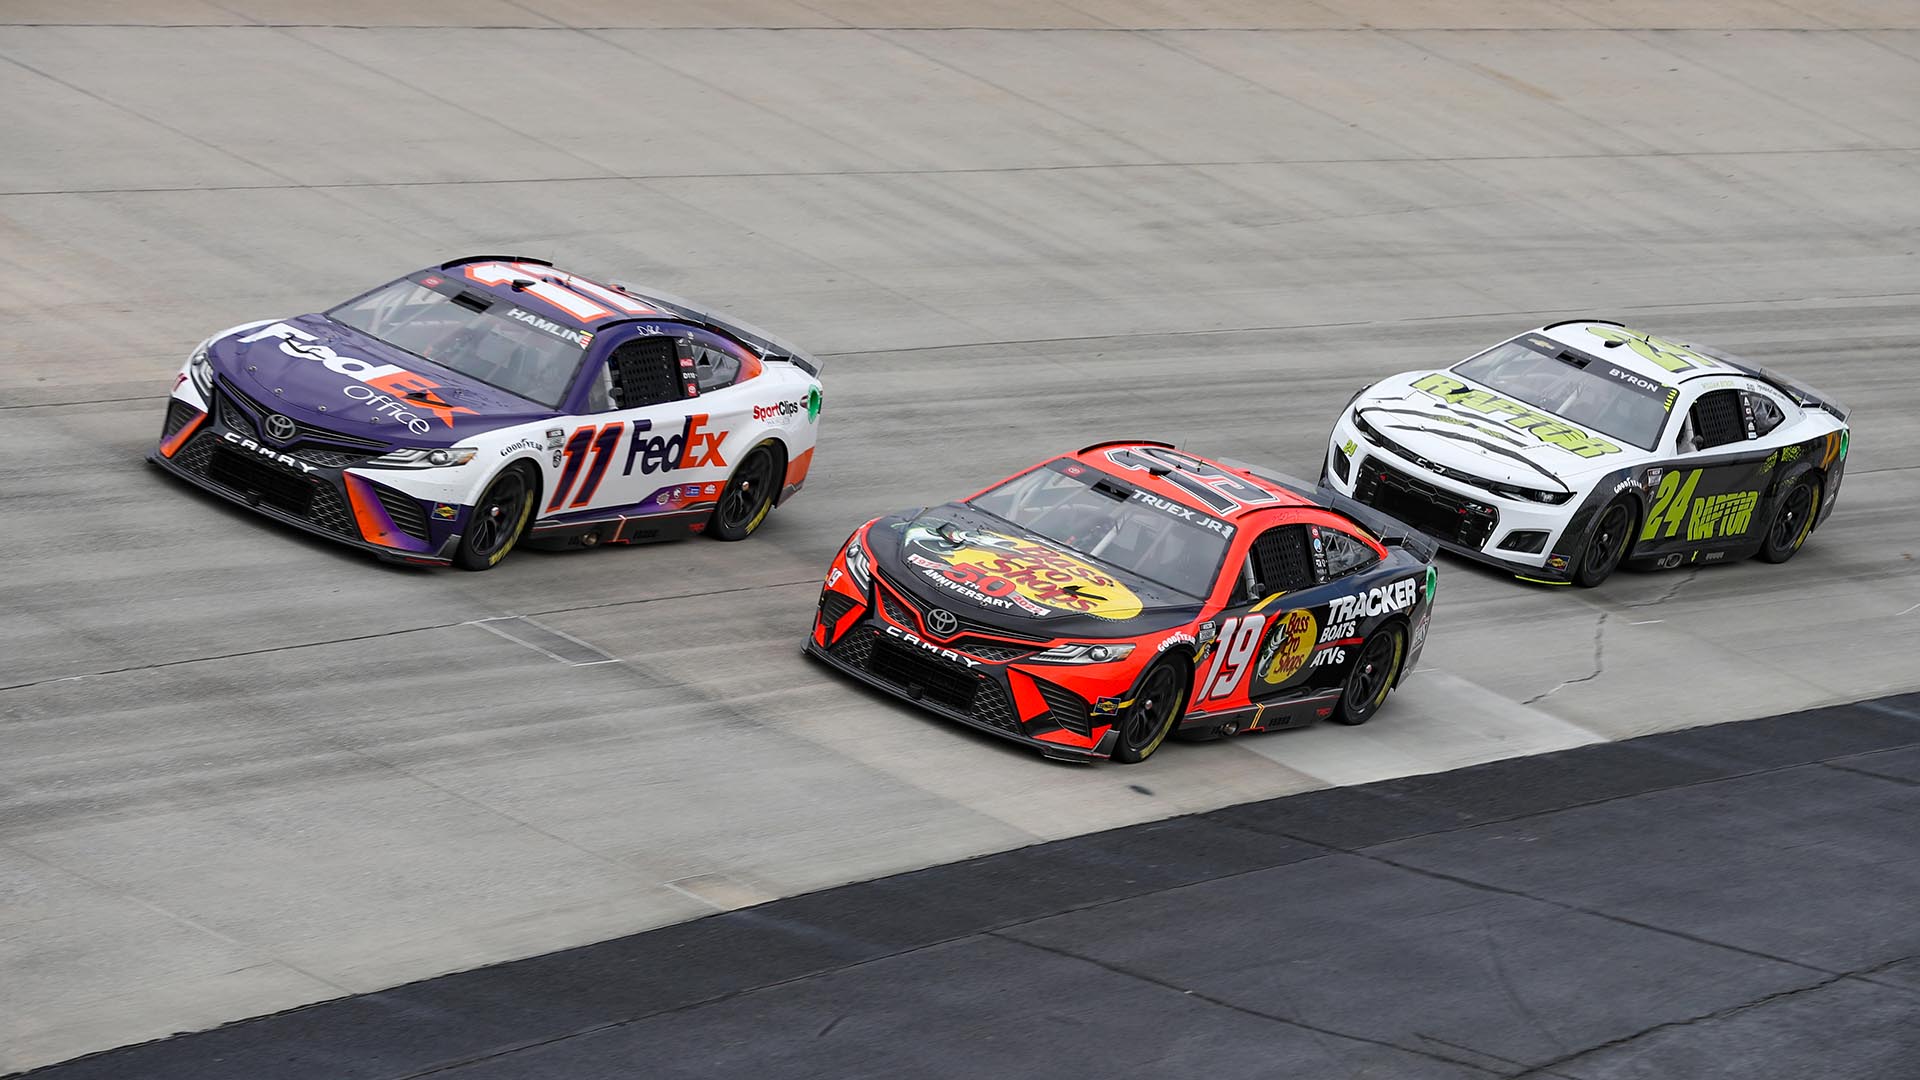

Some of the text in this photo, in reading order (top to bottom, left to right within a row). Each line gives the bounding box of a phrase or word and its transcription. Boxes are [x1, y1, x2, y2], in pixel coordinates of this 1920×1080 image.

[464, 261, 657, 323] 11
[507, 308, 582, 345] HAMLIN
[237, 322, 480, 429] FedEx
[1608, 368, 1659, 392] BYRON
[343, 385, 430, 435] Office
[1409, 373, 1622, 459] RAPTOR
[224, 432, 320, 473] CAMRY
[622, 413, 730, 476] FedEx
[545, 421, 624, 513] 11
[1104, 446, 1281, 517] 19
[1132, 489, 1196, 521] TRUEX
[1640, 469, 1703, 541] 24
[1687, 491, 1760, 541] RAPTOR
[827, 567, 843, 588] 19
[943, 562, 1016, 598] 50
[975, 559, 1098, 612] Shops
[995, 553, 1073, 583] Pro
[1013, 545, 1114, 587] Bass
[922, 569, 1014, 610] ANNIVERSARY
[1326, 577, 1418, 626] TRACKER
[1280, 634, 1301, 654] Pro
[1286, 612, 1310, 635] Bass
[1319, 620, 1357, 644] BOATS
[886, 625, 982, 668] CAMRY
[1197, 613, 1266, 702] 19
[1273, 652, 1305, 676] Shops
[1309, 646, 1346, 668] ATVs
